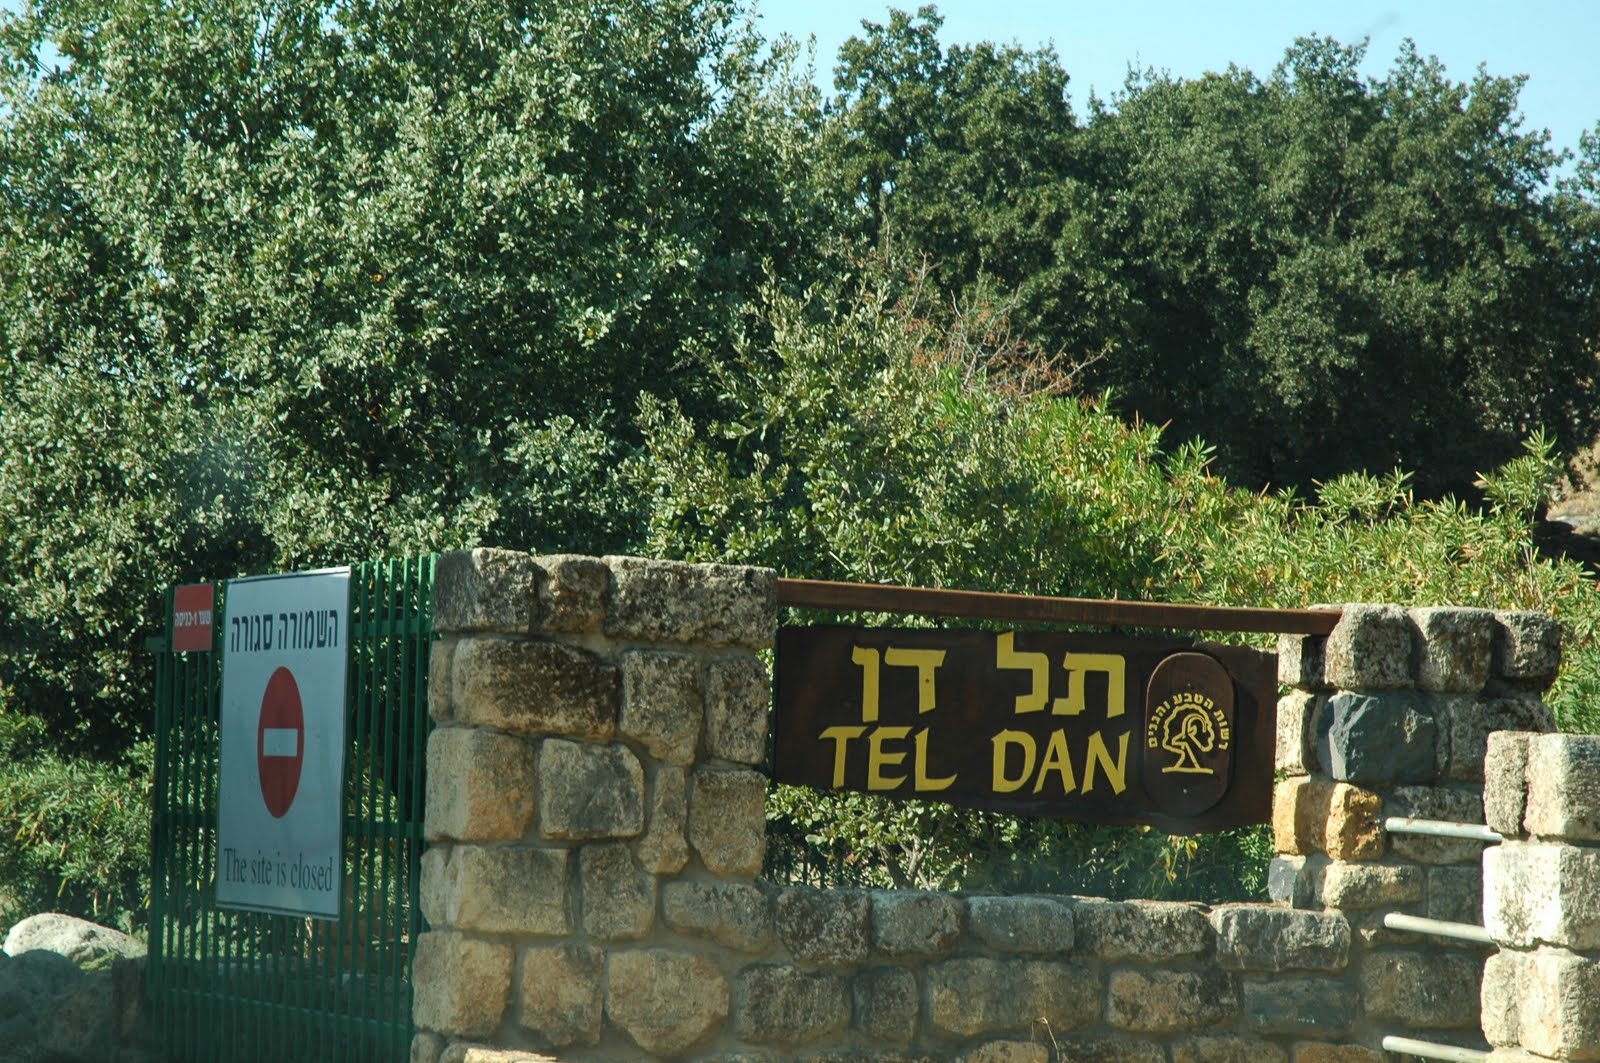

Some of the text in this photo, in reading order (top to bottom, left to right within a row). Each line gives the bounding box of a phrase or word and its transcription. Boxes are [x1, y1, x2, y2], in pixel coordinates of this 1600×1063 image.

[230, 609, 339, 653] השמורה סגורה
[851, 630, 1127, 723] תל דן
[1147, 692, 1230, 751] רשות הטבע והגנים
[818, 725, 1131, 796] TEL DAN
[223, 847, 333, 892] The site is closed
